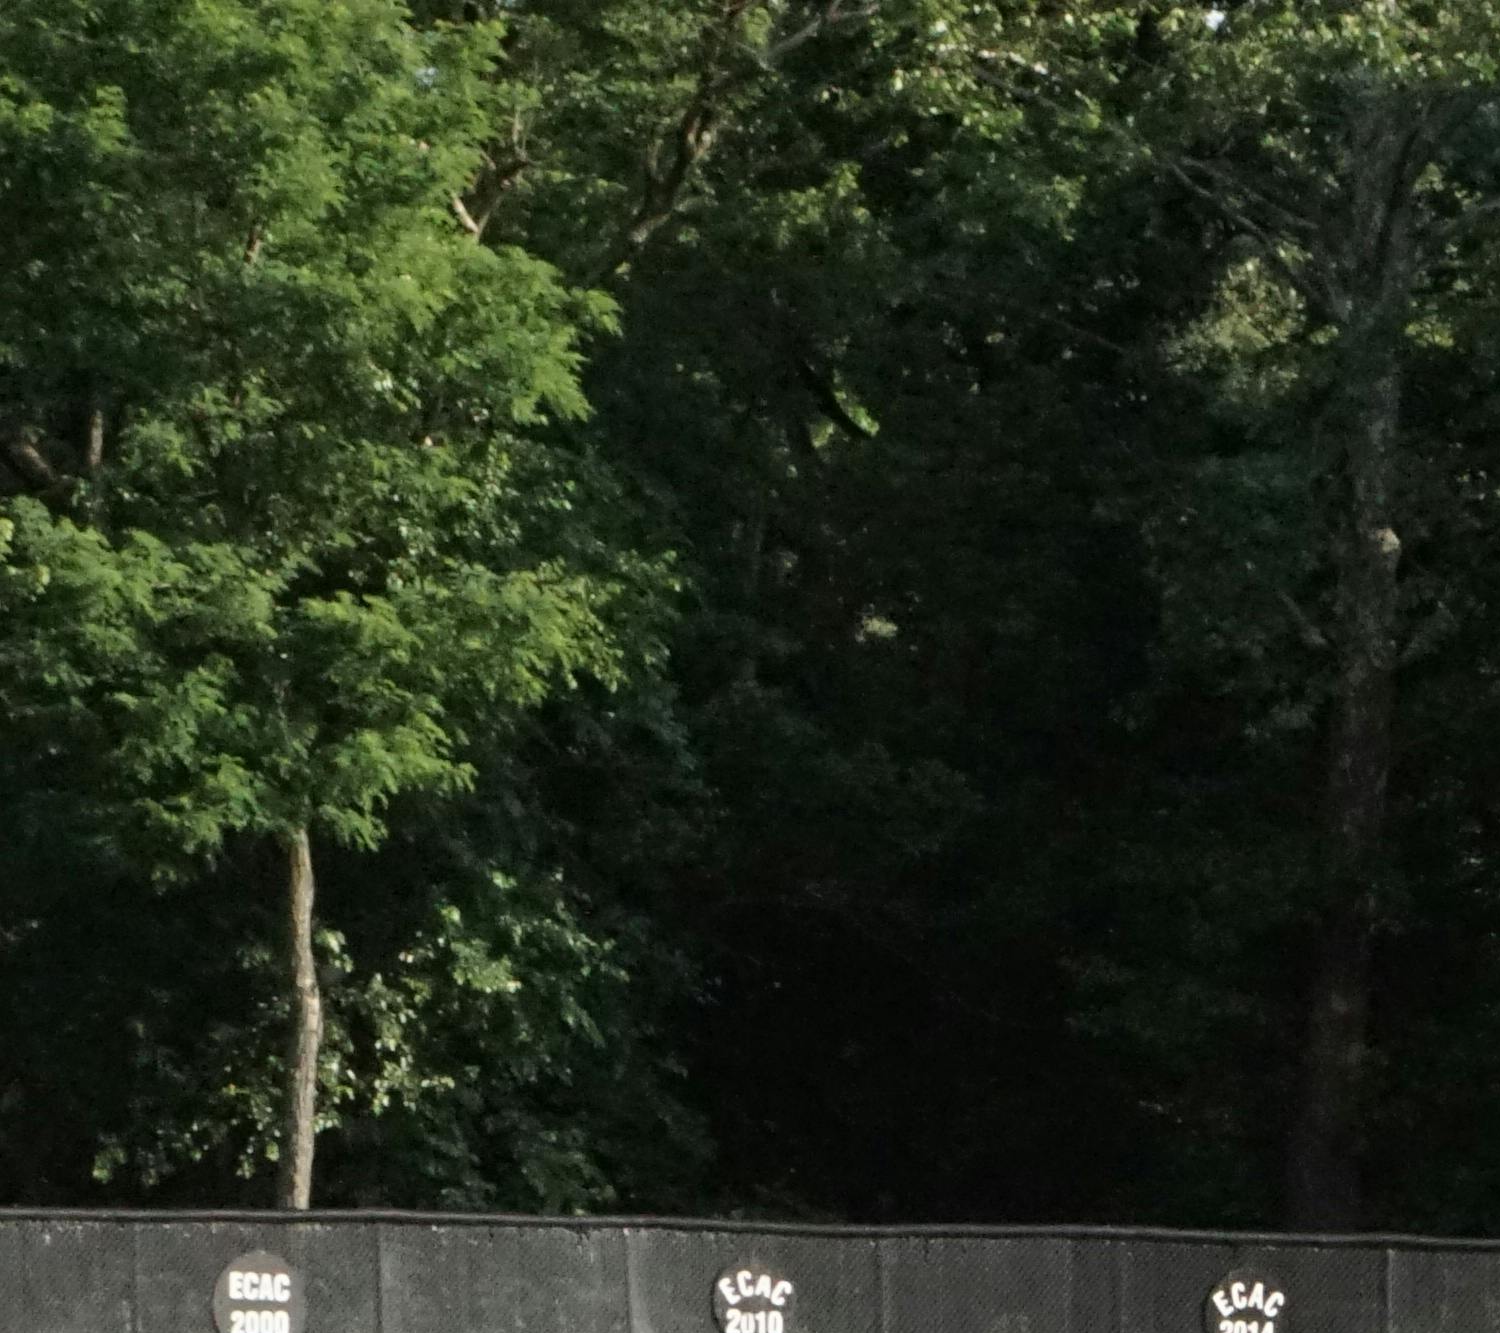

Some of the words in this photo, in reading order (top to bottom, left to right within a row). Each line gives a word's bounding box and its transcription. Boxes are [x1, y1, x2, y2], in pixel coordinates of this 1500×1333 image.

[229, 1271, 291, 1302] ECAC
[719, 1270, 793, 1306] ECAC
[1213, 1282, 1285, 1317] ECAC
